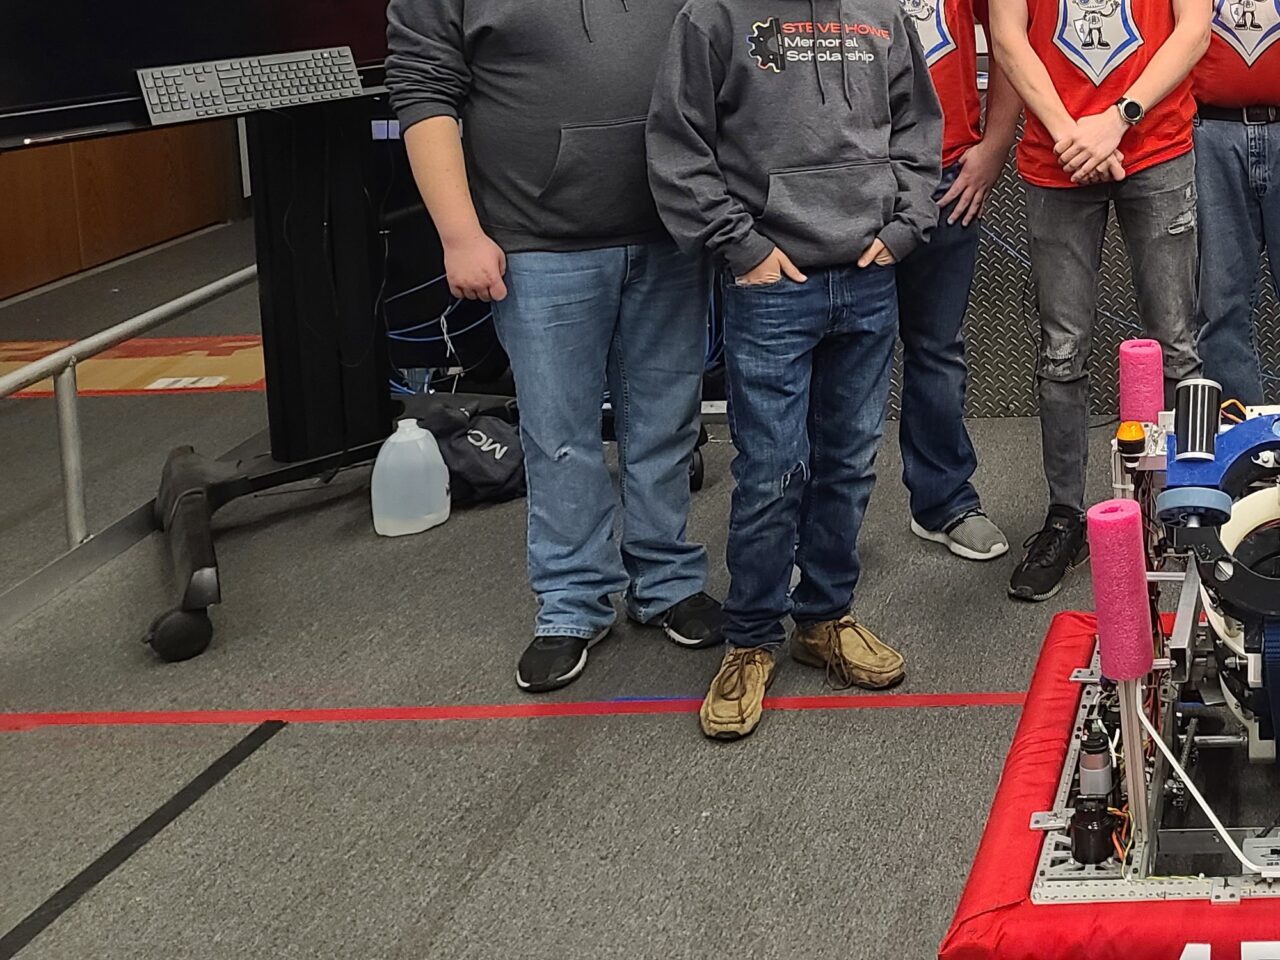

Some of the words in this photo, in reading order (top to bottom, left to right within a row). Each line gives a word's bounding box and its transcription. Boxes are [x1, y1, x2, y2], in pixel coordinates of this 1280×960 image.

[782, 22, 841, 34] STEVE
[844, 23, 891, 40] HOWE
[784, 36, 859, 48] Memoral
